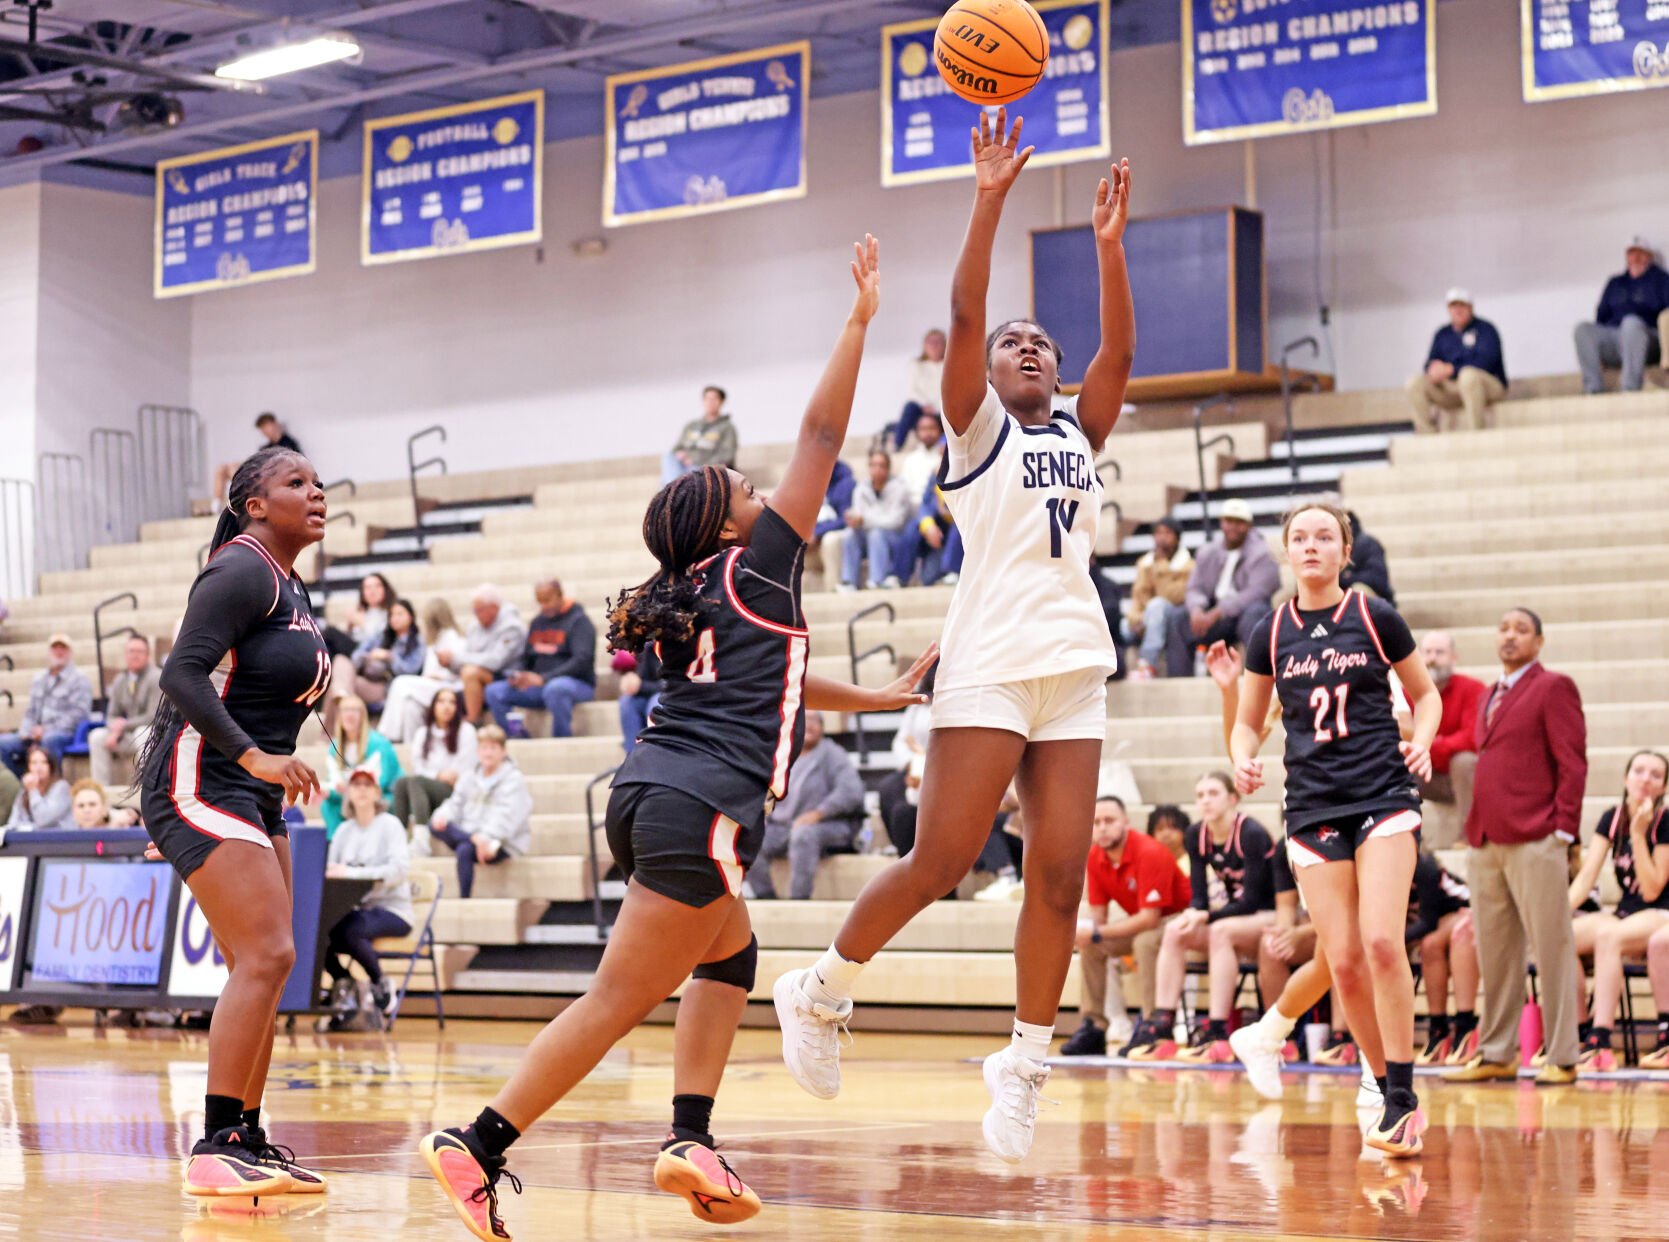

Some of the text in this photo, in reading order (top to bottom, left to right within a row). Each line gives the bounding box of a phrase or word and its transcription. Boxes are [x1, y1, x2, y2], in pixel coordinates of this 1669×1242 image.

[1198, 1, 1419, 53] REGION CHAMPIONS
[937, 47, 998, 94] Wilson
[1022, 451, 1095, 493] SENECA
[685, 626, 718, 684] 4
[1282, 647, 1369, 679] Lady Tigers
[1309, 682, 1350, 743] 21
[47, 864, 160, 956] Hood
[85, 963, 156, 981] DENTISTRY
